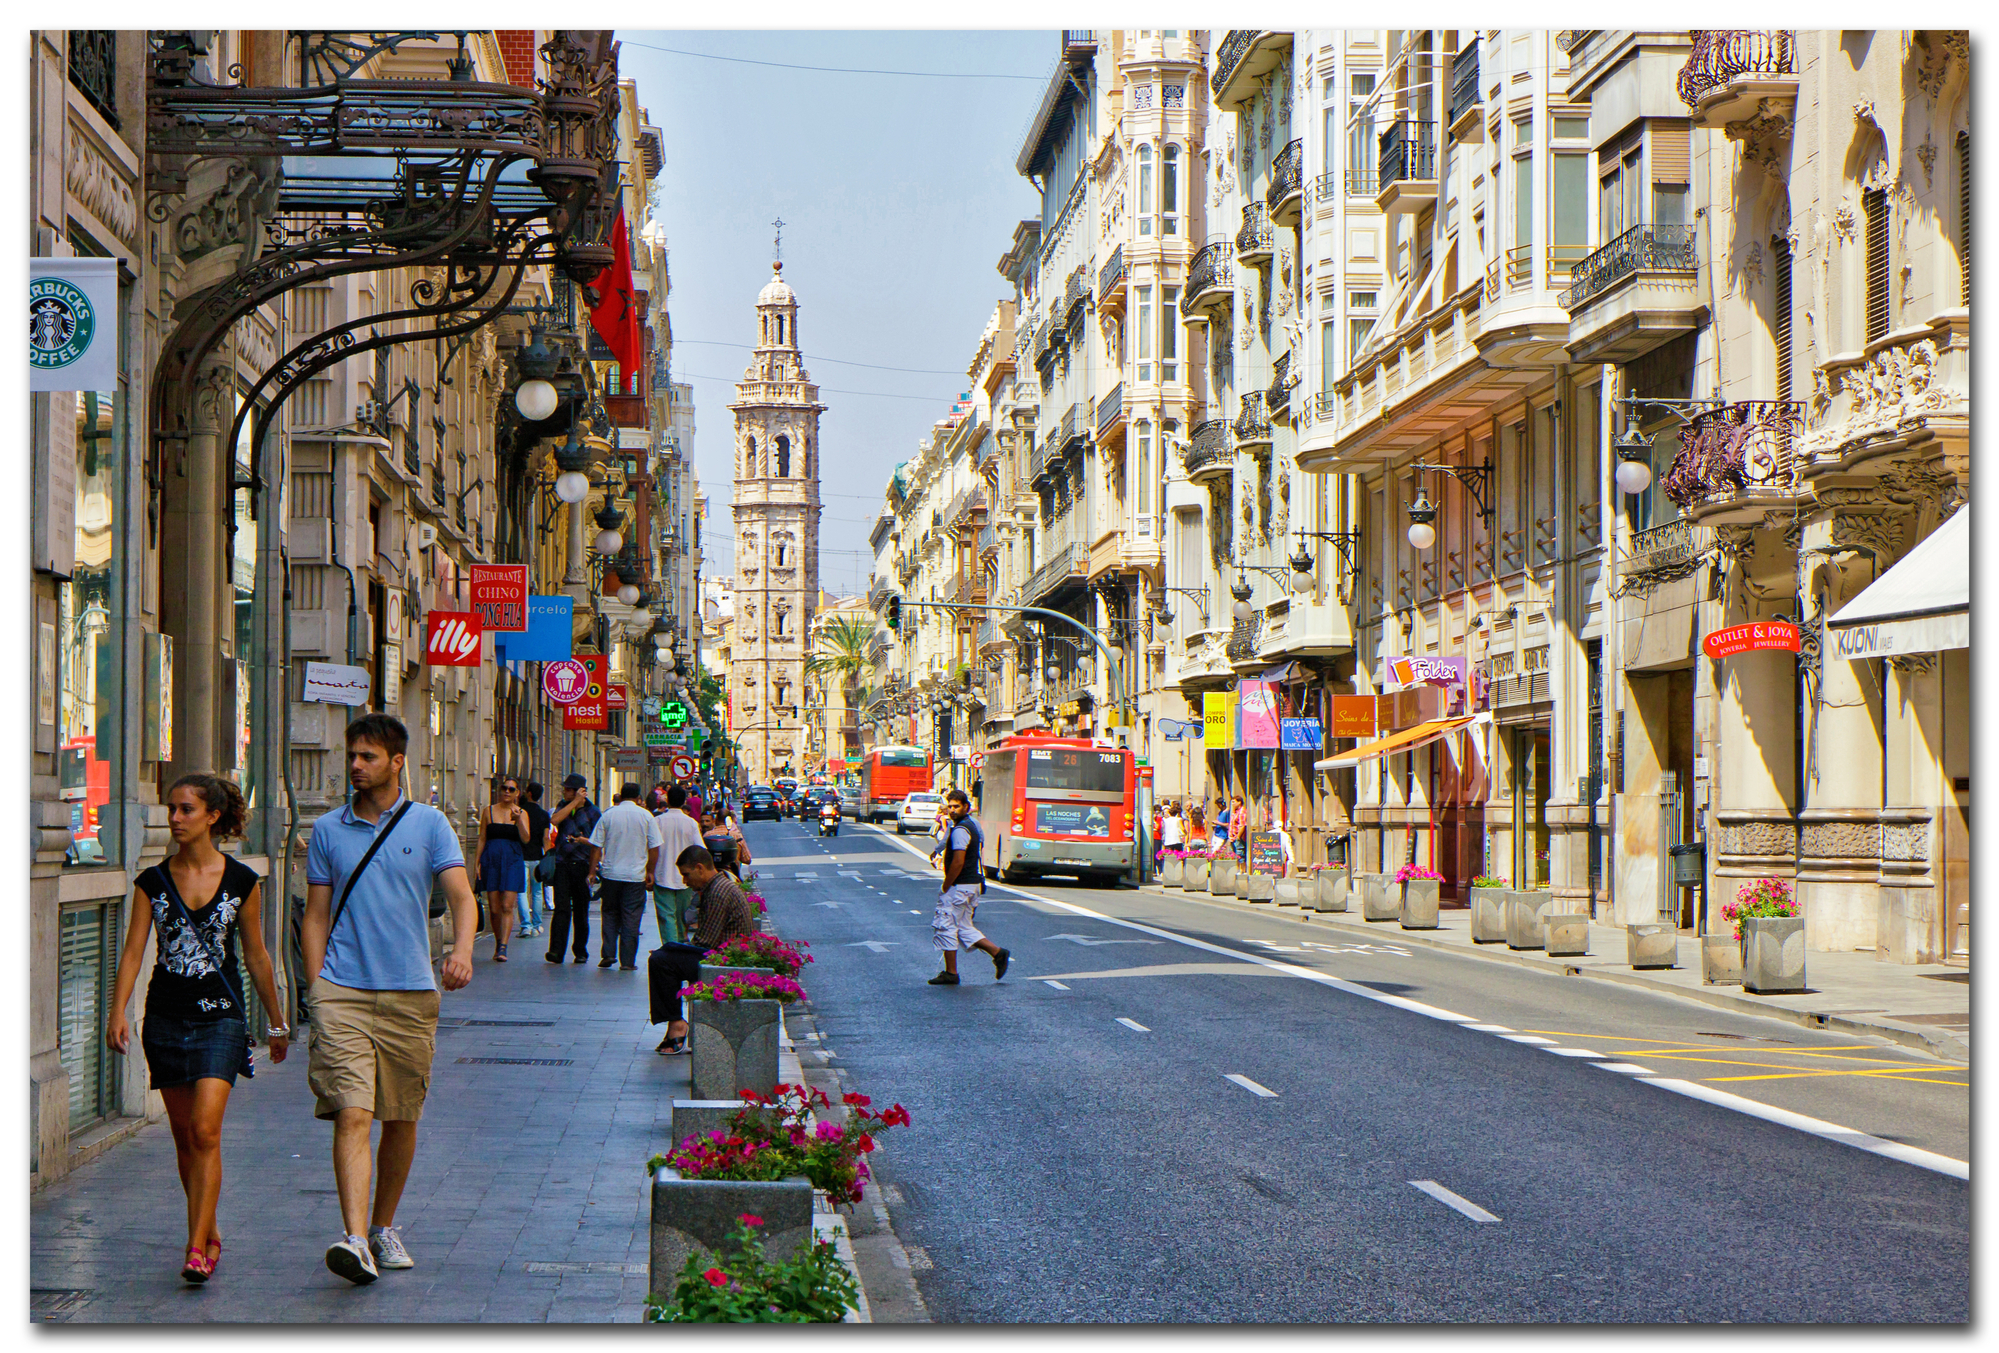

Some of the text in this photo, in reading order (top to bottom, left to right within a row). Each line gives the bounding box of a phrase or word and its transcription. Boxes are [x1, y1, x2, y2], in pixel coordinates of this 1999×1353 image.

[30, 282, 90, 320] RBUCKS
[473, 568, 522, 584] RESTAURANTE
[477, 587, 520, 599] CHINO
[502, 603, 522, 627] HUA
[429, 618, 480, 662] illy
[1709, 625, 1793, 647] OUTLET & JOYA
[1838, 626, 1894, 656] KUONI VIAJES
[1719, 640, 1791, 655] JOYERIA JEWELLERY
[550, 660, 583, 674] cupcake
[1409, 659, 1456, 679] Folder
[549, 686, 583, 700] valencia
[568, 703, 602, 717] nest
[1335, 710, 1358, 722] Soins
[575, 717, 602, 725] Hostel
[1204, 715, 1226, 724] ORO
[1283, 719, 1321, 728] JOYERÍA
[1063, 754, 1077, 765] 26
[1098, 753, 1121, 763] 7083
